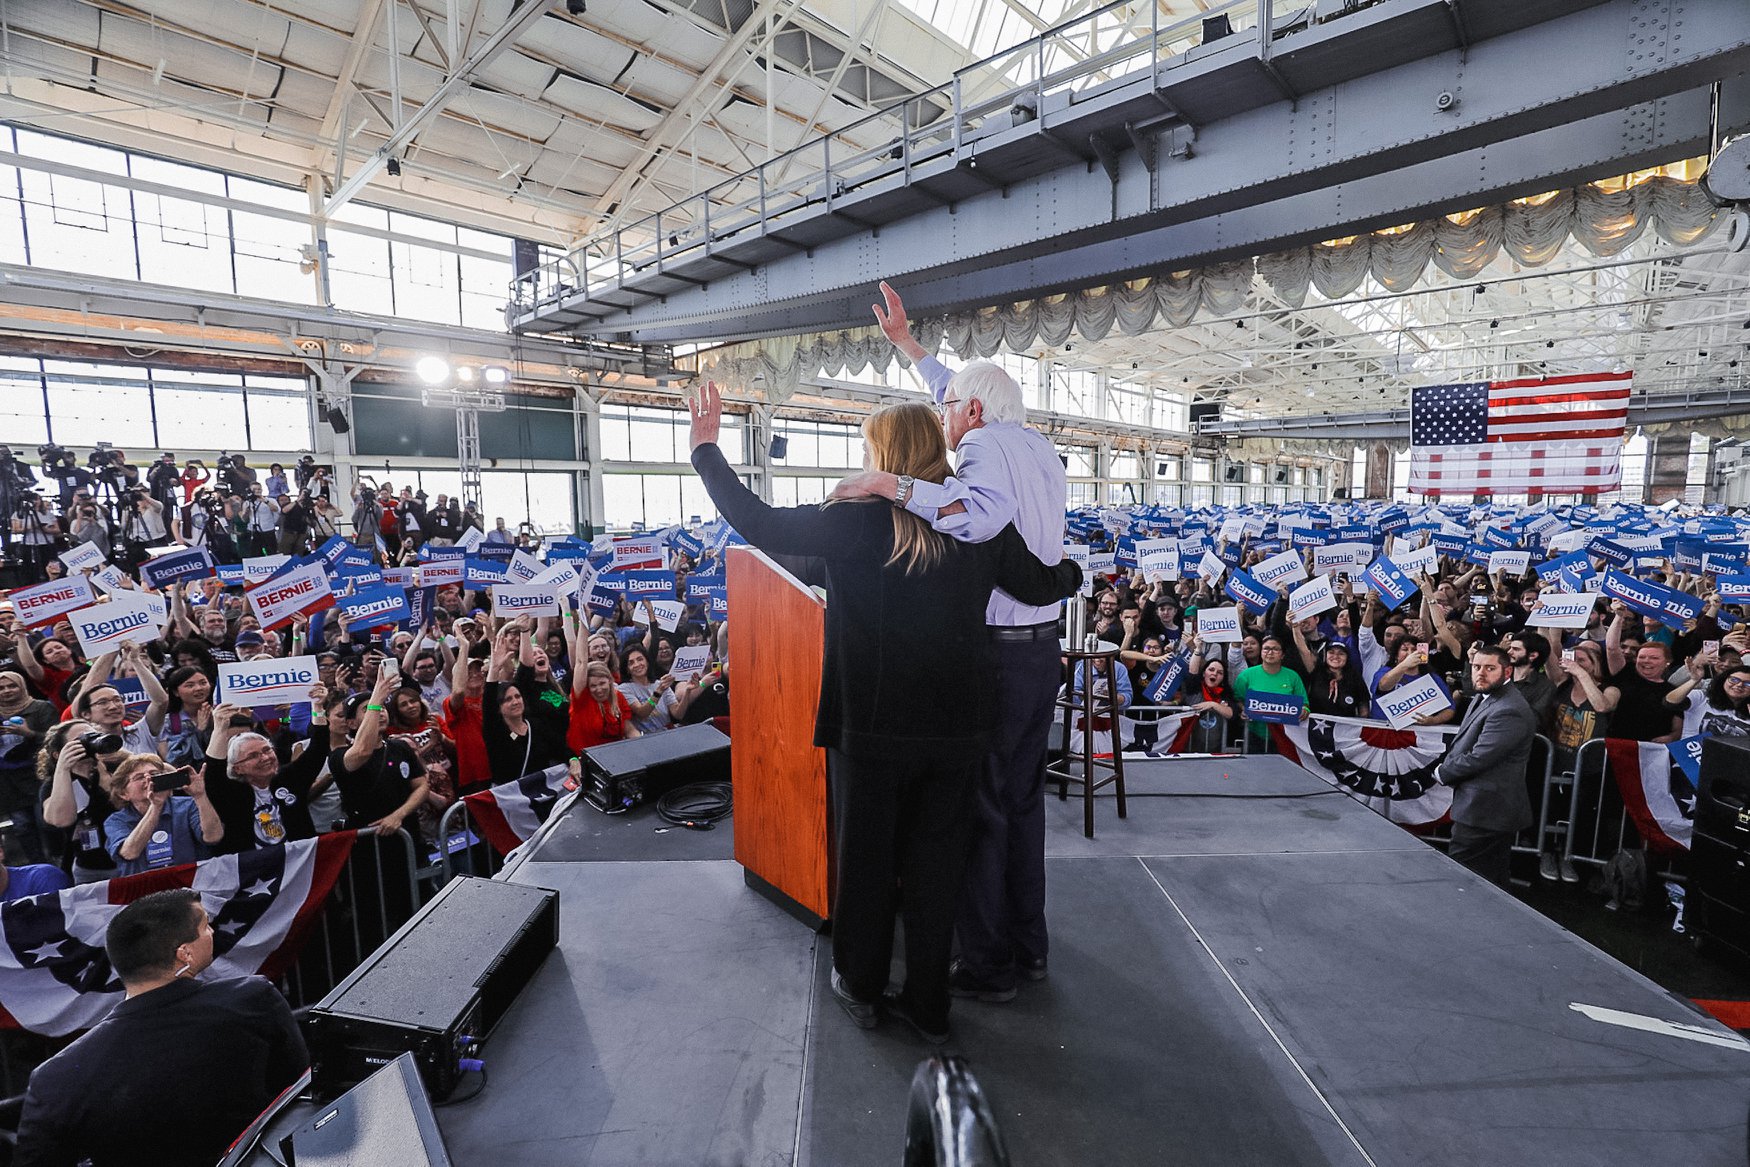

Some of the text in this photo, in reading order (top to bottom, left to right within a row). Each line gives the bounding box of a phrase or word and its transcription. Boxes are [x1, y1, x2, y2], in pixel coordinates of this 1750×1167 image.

[1532, 519, 1557, 533] Bernie
[1294, 533, 1326, 545] Bernie
[1341, 530, 1369, 538] Bernie
[1486, 530, 1512, 548] Bernie
[676, 533, 700, 553] Bernie
[1432, 539, 1464, 551] Bernie
[326, 541, 347, 560] rnie
[430, 552, 464, 560] Bernie
[480, 547, 513, 555] Bernie
[617, 546, 652, 555] BERNIE
[1119, 548, 1137, 558] Ber
[1224, 552, 1239, 562] nie
[1356, 549, 1370, 557] nie
[1591, 541, 1628, 561] Bernie
[1317, 552, 1354, 565] Bernie
[1492, 555, 1525, 566] Bernie
[154, 559, 204, 581] Bernie
[248, 565, 278, 574] Bern
[423, 569, 460, 577] BERNIE
[1144, 560, 1175, 572] Bernie
[1258, 559, 1299, 582] Bernie
[1542, 560, 1588, 581] Benie
[1707, 562, 1739, 576] ernie
[220, 570, 244, 579] Bern
[384, 575, 402, 583] NIE
[467, 568, 507, 583] Bernie
[1370, 563, 1406, 600] Bernie
[629, 579, 673, 591] Bernie
[1230, 576, 1269, 607] Bernie
[1606, 575, 1661, 608] Bernie
[1720, 582, 1750, 593] Ber
[18, 589, 76, 610] BERNIE
[257, 580, 314, 608] BERNIE
[498, 594, 554, 606] Bernie
[1292, 586, 1329, 609] Bernie
[346, 595, 404, 617] Bernie
[409, 589, 424, 628] Bernie
[591, 595, 615, 608] rnie
[1537, 603, 1588, 615] Bernie
[1664, 600, 1694, 618] nie
[80, 611, 150, 640] Bernie
[1200, 617, 1236, 631] Bernie
[675, 656, 706, 669] Bernie
[227, 668, 312, 690] Bernie
[1153, 661, 1182, 702] Bernie
[1248, 698, 1299, 716] Bernie
[1386, 685, 1438, 717] Bernie
